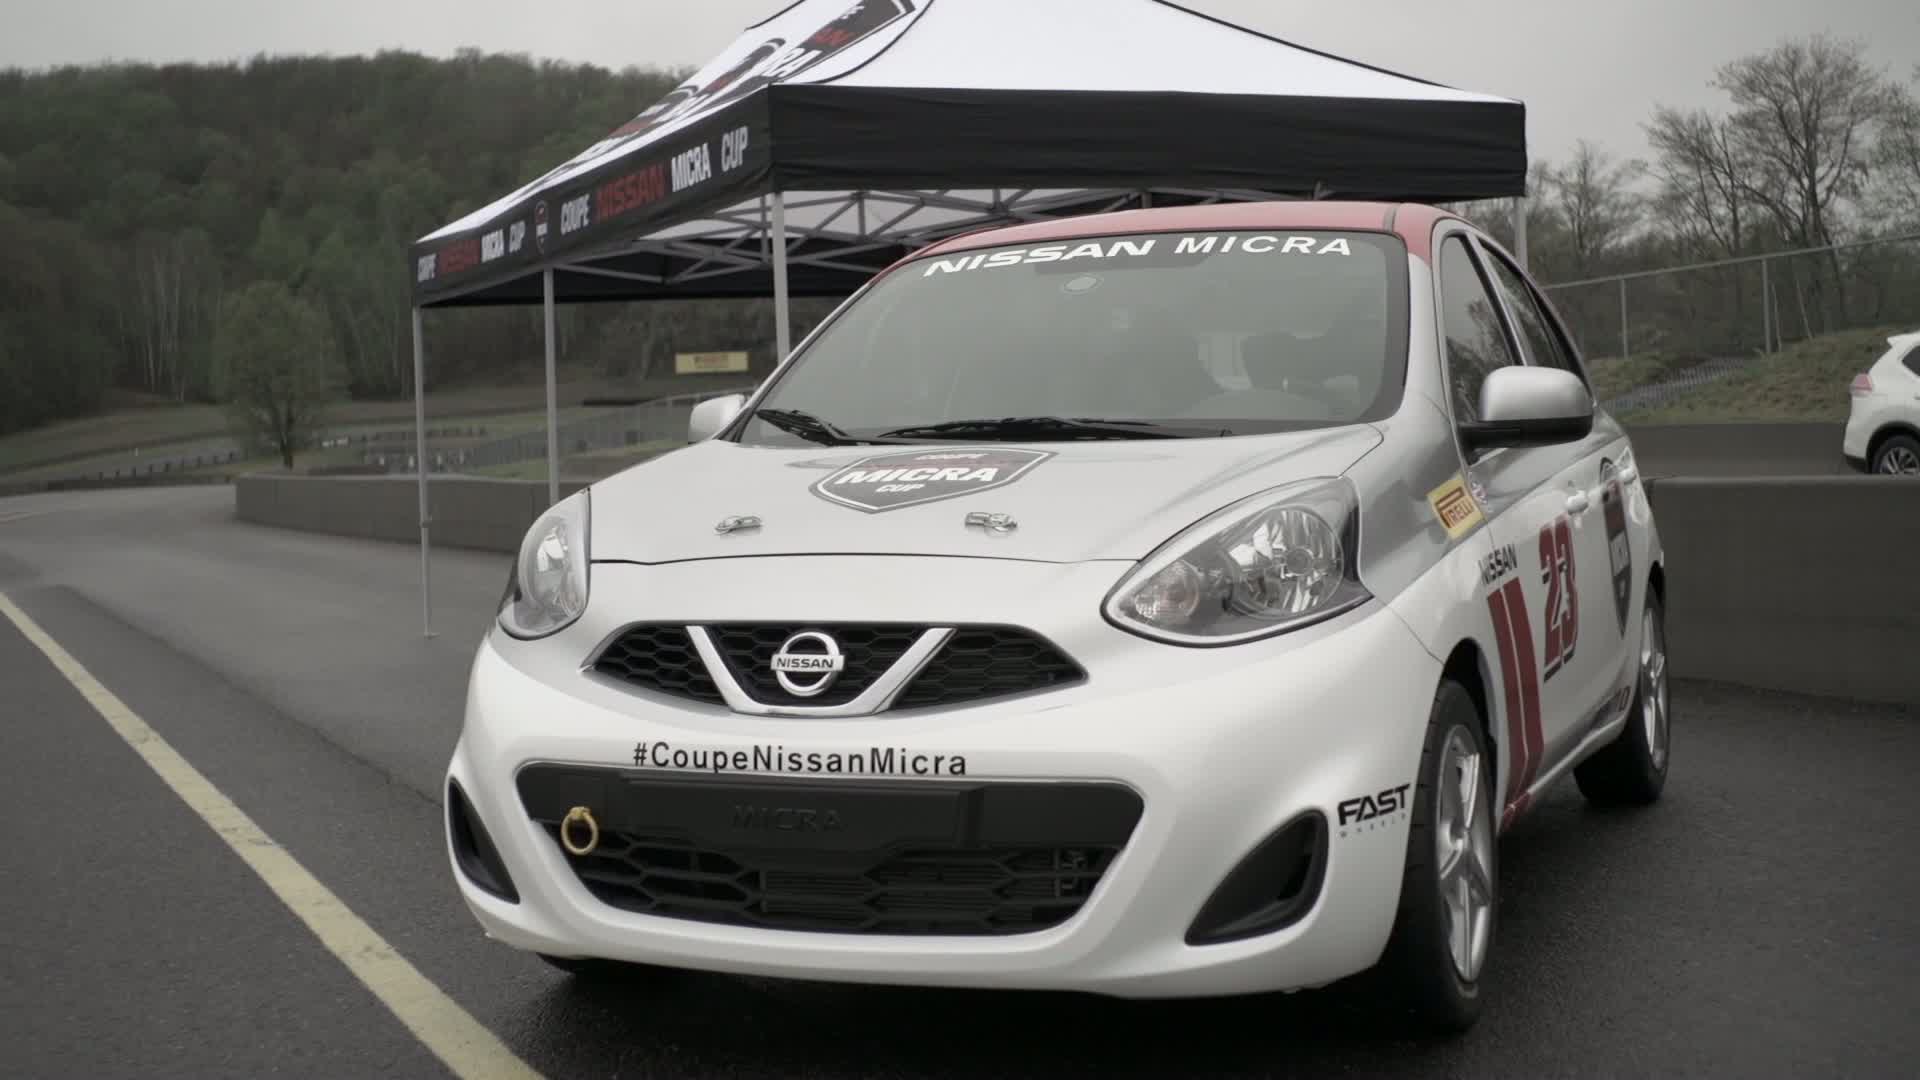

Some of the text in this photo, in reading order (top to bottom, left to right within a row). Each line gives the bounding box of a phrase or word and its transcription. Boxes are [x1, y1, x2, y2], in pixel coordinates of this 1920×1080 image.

[561, 126, 748, 234] COUPE NISSAN MICRA CUP
[481, 229, 504, 263] MICRA
[509, 220, 526, 253] CUP
[923, 236, 1352, 277] NISSAN MICRA
[834, 467, 999, 485] MICRA
[875, 483, 925, 493] CUP
[1434, 486, 1475, 529] PIRELLI
[1478, 543, 1517, 584] NISSAN
[1539, 513, 1579, 683] 23
[776, 657, 834, 669] NISSAN
[633, 741, 967, 776] #CoupeNissanMicra
[731, 803, 846, 831] MICRA
[1338, 783, 1411, 826] FAST
